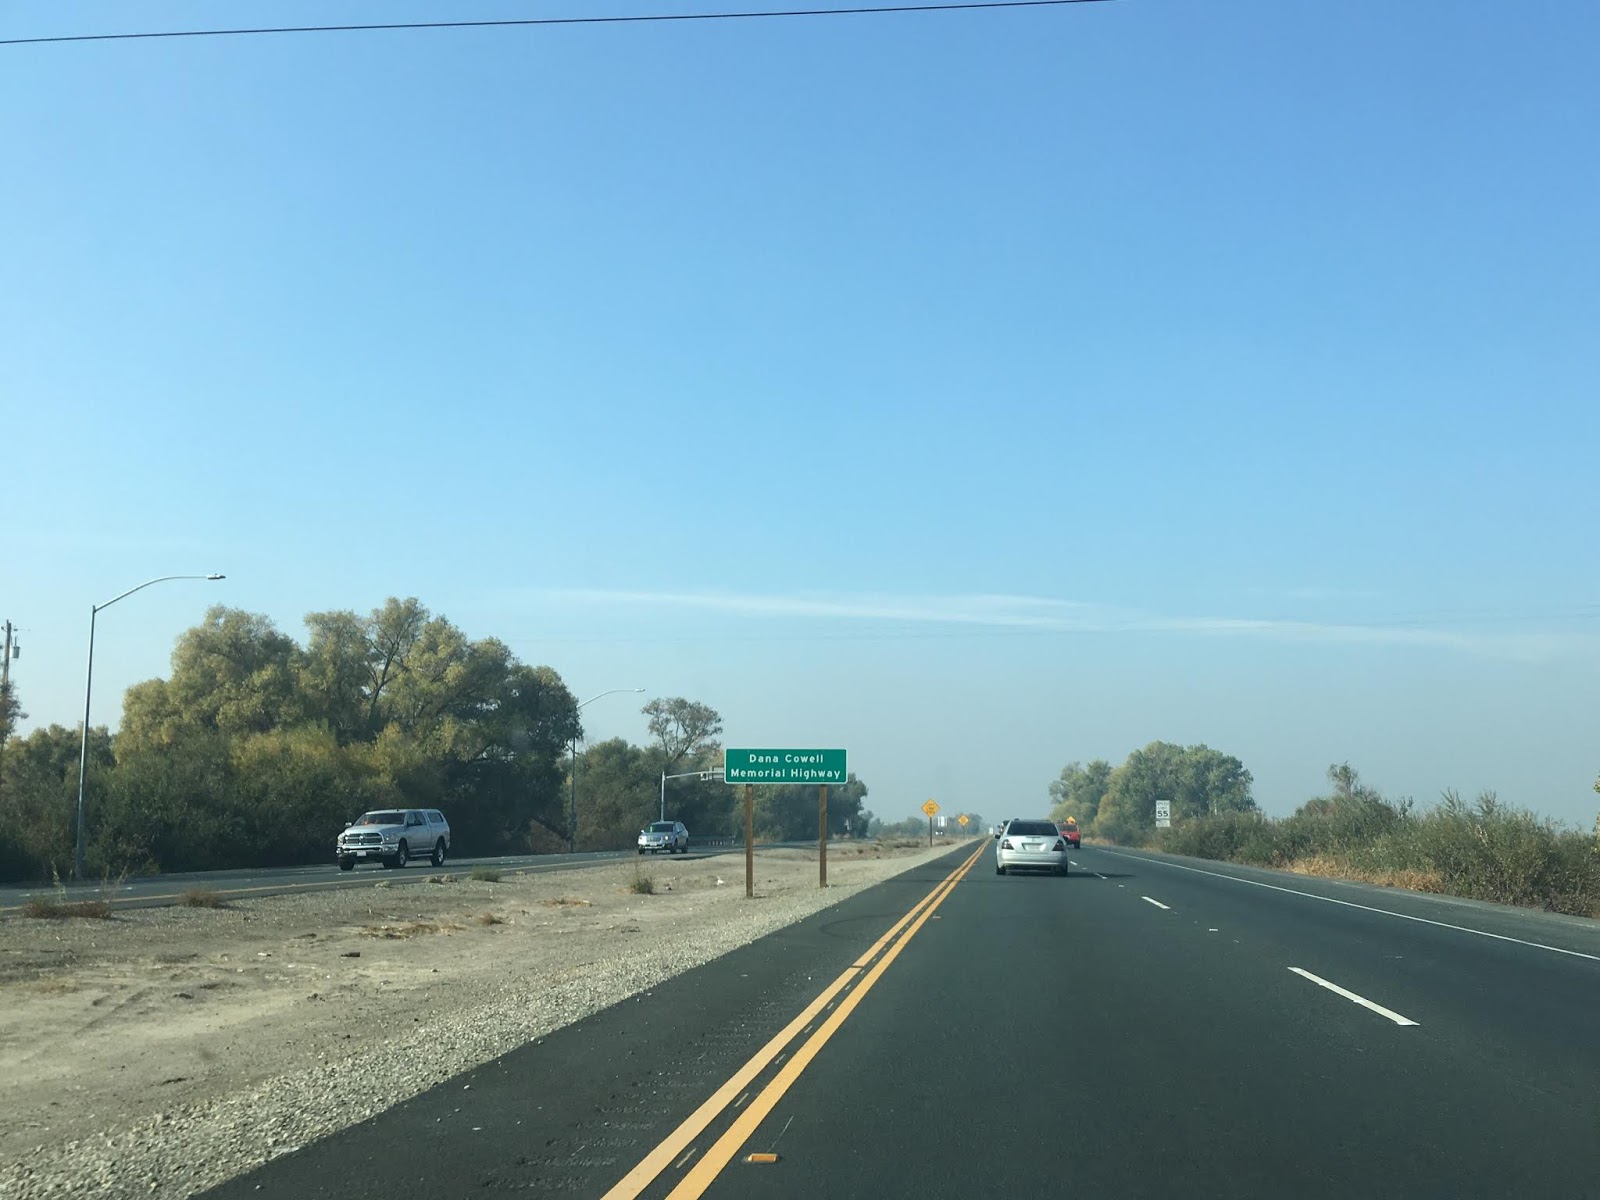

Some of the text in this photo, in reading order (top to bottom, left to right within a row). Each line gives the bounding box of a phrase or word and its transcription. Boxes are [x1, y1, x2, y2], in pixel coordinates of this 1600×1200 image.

[749, 754, 824, 763] Dana Cowell
[730, 768, 841, 779] Memorial Highway
